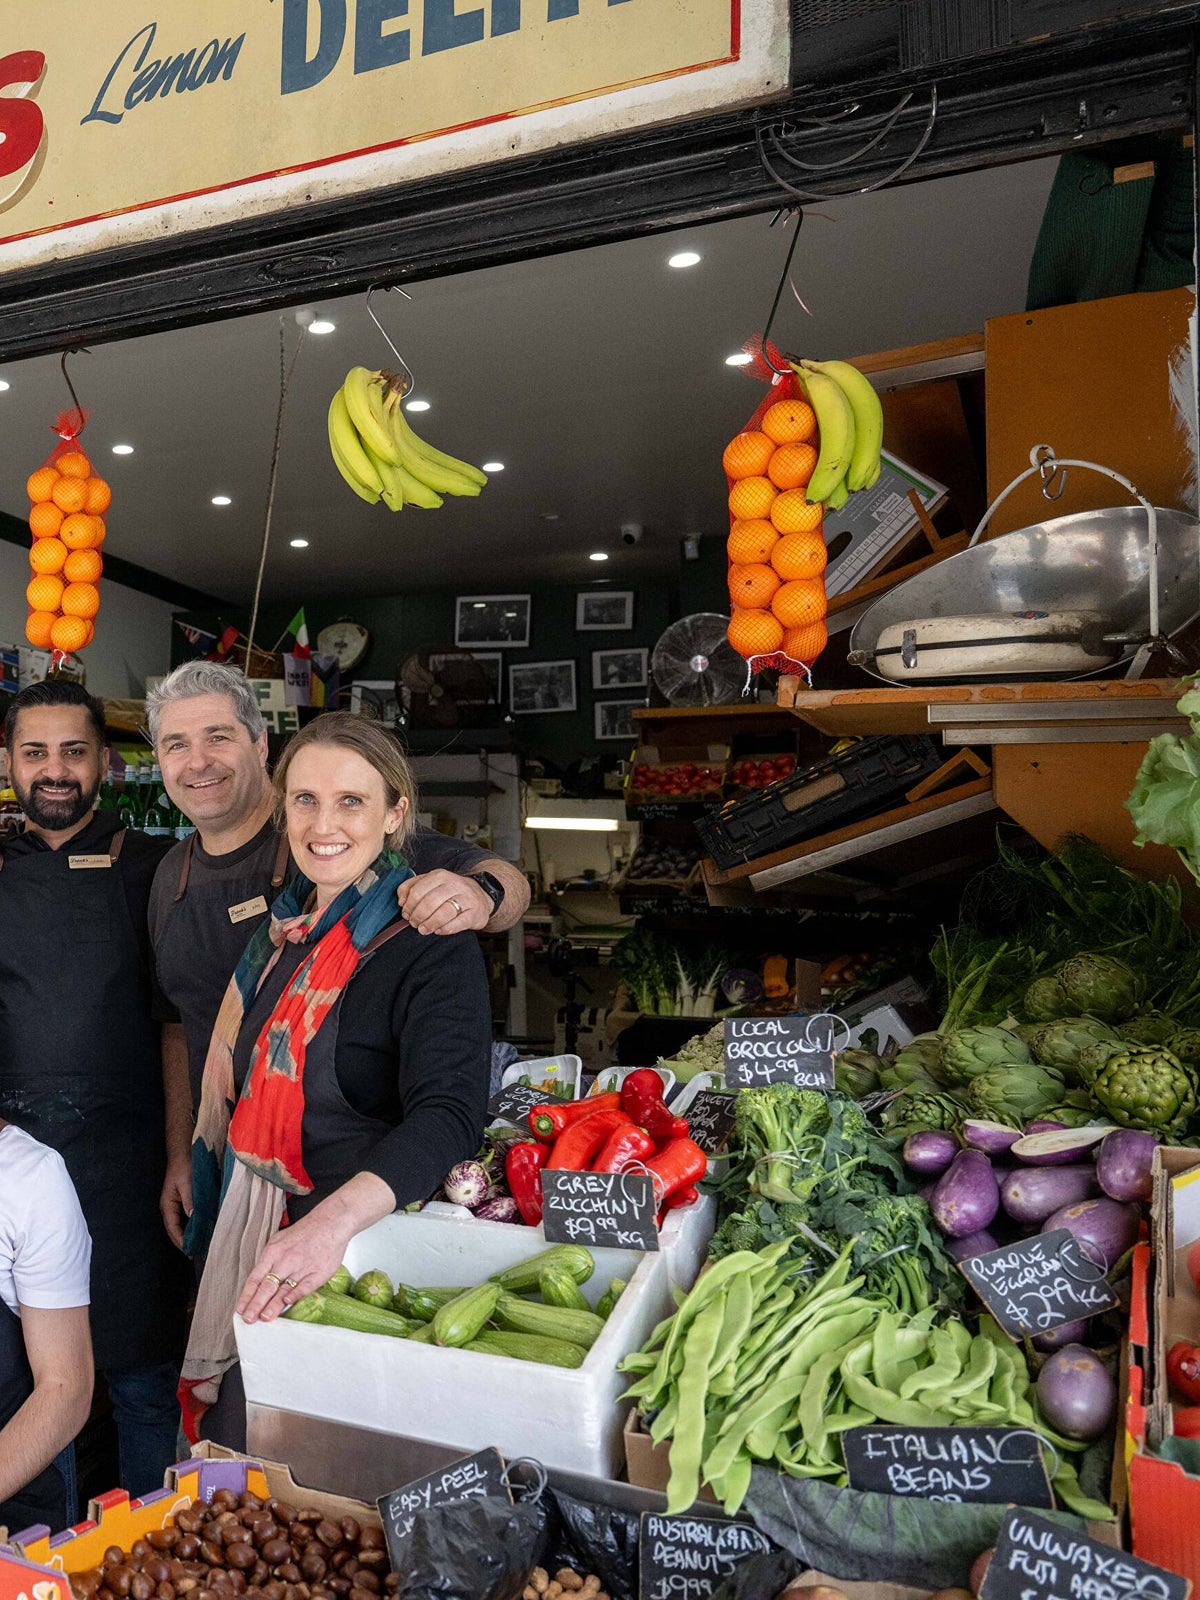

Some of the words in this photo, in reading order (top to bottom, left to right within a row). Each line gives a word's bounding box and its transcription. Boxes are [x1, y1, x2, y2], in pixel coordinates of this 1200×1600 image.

[80, 22, 245, 125] Lemon
[732, 1020, 790, 1038] LOCAL
[726, 1036, 822, 1060] BROCCOLI
[794, 1071, 826, 1087] BCH
[556, 1174, 615, 1197] GREY
[617, 1230, 645, 1250] KG
[1076, 1285, 1111, 1308] KG
[861, 1432, 998, 1466] ITALIAN
[887, 1463, 992, 1494] BEANS
[651, 1543, 736, 1577] PEANUTS
[1008, 1549, 1058, 1586] FUJI
